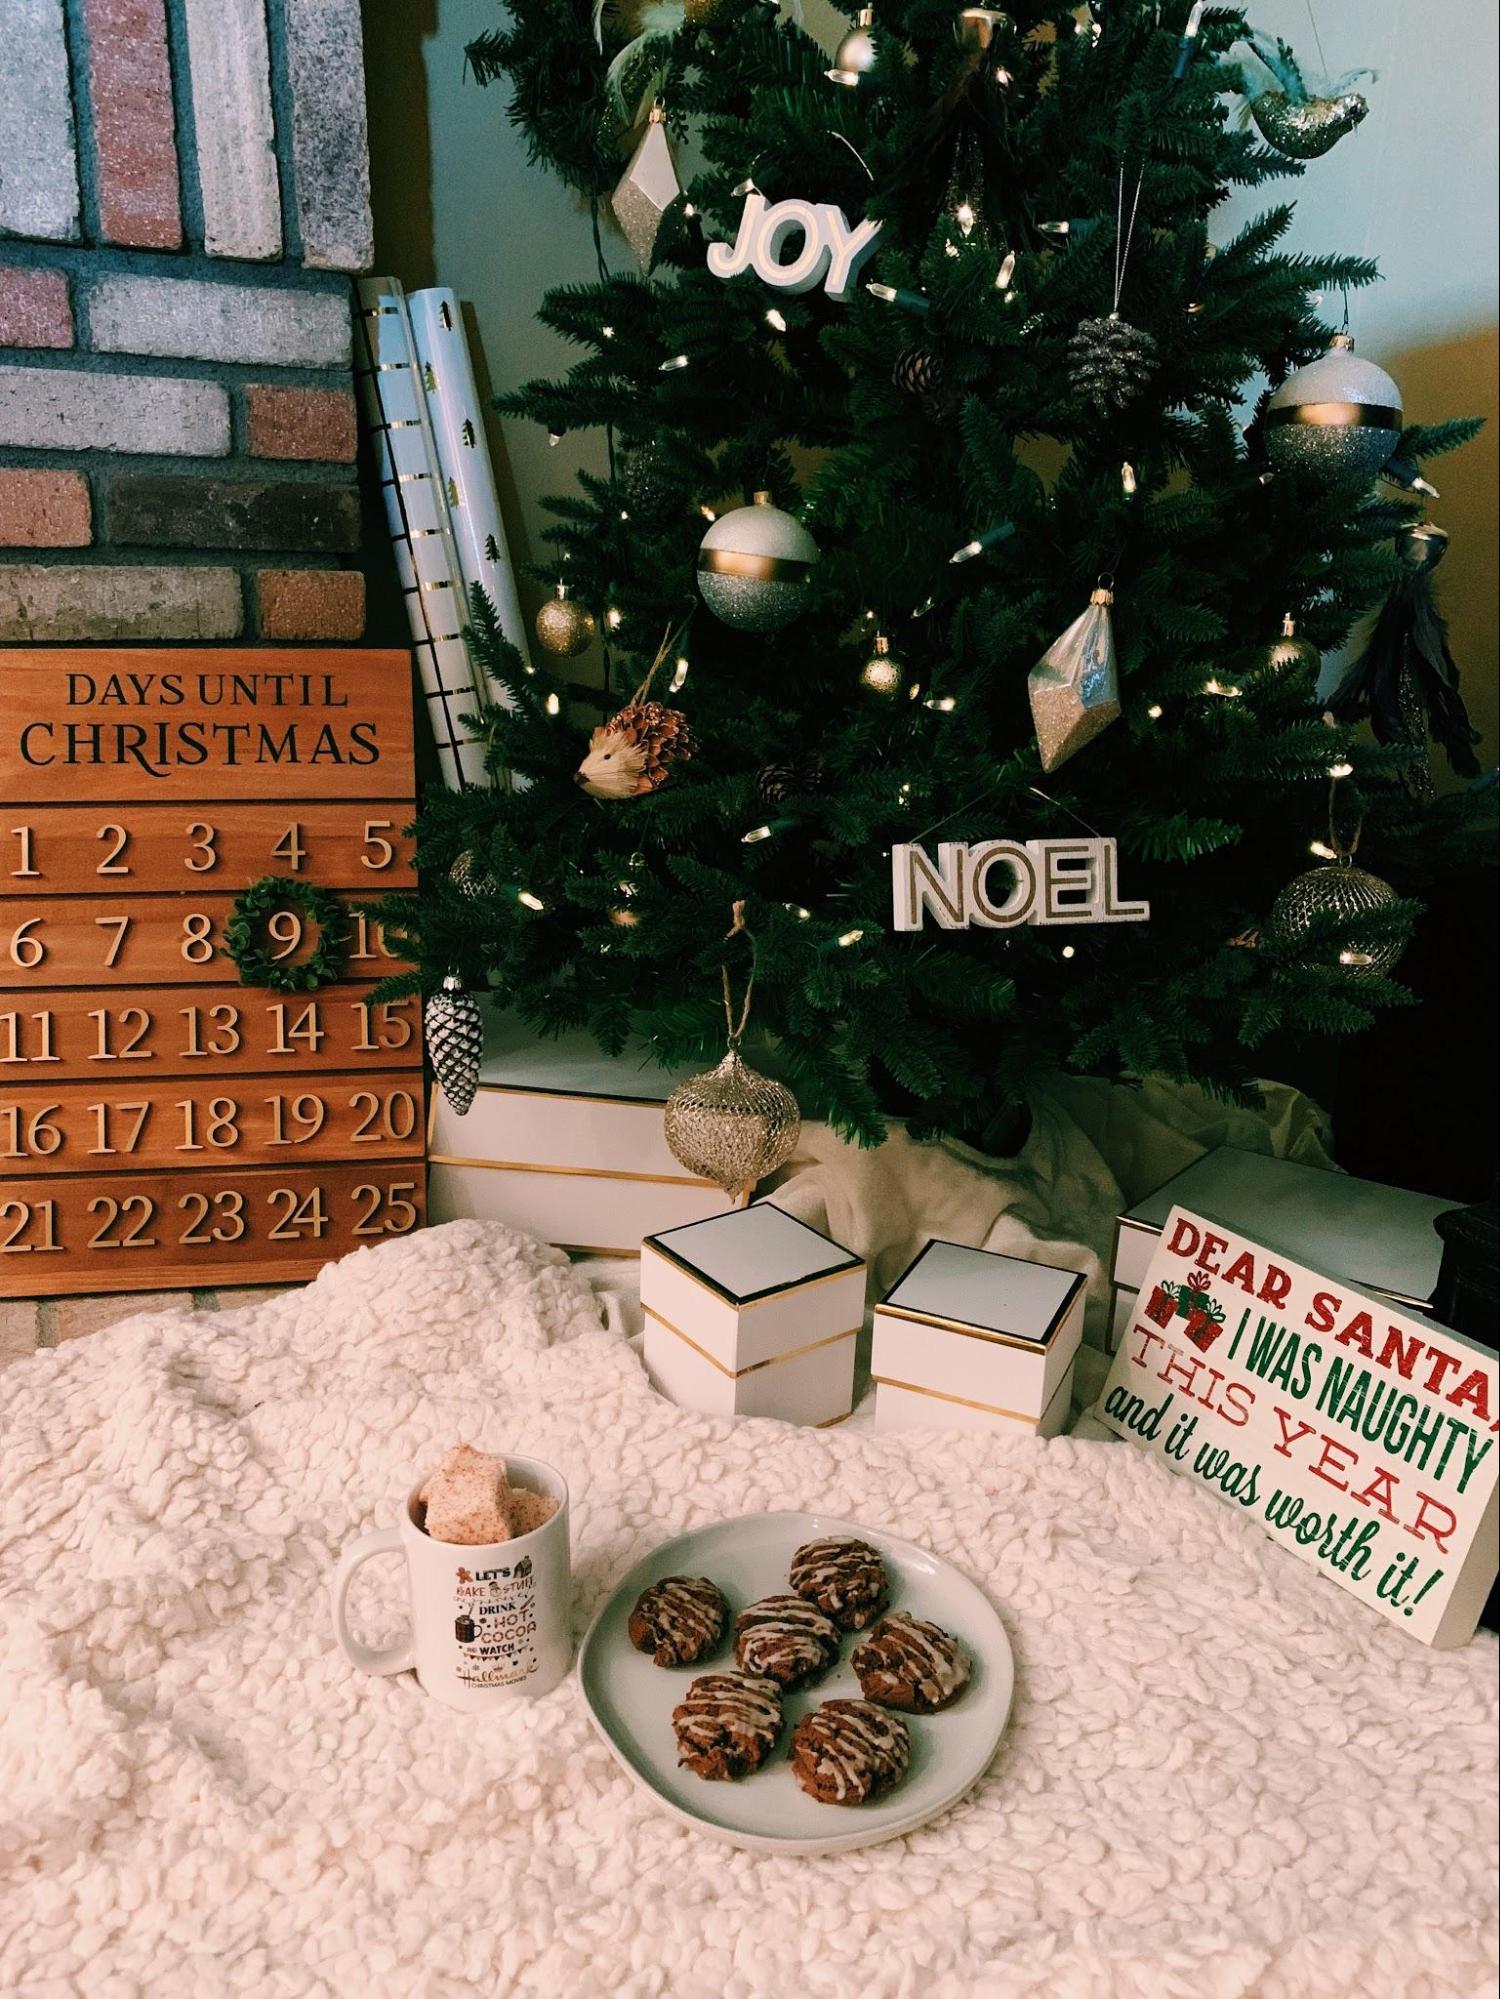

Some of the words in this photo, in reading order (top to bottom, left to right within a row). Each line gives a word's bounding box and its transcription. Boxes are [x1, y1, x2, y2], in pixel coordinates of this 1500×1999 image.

[706, 193, 886, 301] JOY
[66, 673, 185, 706] DAYS
[197, 673, 348, 707] UNTIL
[20, 721, 381, 778] CHRISTMAS
[10, 825, 41, 877] 1
[95, 824, 130, 875] 2
[183, 821, 218, 872] 3
[270, 821, 307, 871] 4
[359, 819, 394, 870] 5
[892, 837, 1150, 932] NOEL
[9, 917, 45, 968] 6
[94, 915, 130, 967] 7
[180, 912, 214, 965] 8
[267, 910, 301, 962] 9
[0, 1010, 61, 1063] 11
[87, 1007, 153, 1060] 12
[178, 1004, 241, 1056] 13
[266, 1002, 325, 1053] 14
[350, 1000, 412, 1051] 15
[0, 1103, 63, 1158] 16
[86, 1101, 151, 1155] 17
[174, 1097, 240, 1150] 18
[263, 1094, 326, 1145] 19
[348, 1090, 416, 1142] 20
[0, 1200, 65, 1253] 21
[86, 1195, 156, 1249] 22
[178, 1191, 246, 1244] 23
[266, 1186, 329, 1239] 24
[350, 1182, 417, 1236] 25
[1167, 1217, 1293, 1310] DEAR
[1304, 1291, 1499, 1432] SANTA,
[1226, 1307, 1253, 1360] I
[1245, 1315, 1323, 1400] WAS
[1315, 1355, 1495, 1495] NAUGHTY
[1130, 1324, 1257, 1428] THIS
[1272, 1406, 1458, 1555] YEAR
[1103, 1383, 1163, 1443] and
[1163, 1412, 1194, 1462] it
[1193, 1442, 1262, 1507] was
[1264, 1487, 1382, 1581] worth
[1376, 1551, 1445, 1618] it!
[456, 1586, 486, 1597] BAKE
[475, 1567, 511, 1582] LET'S
[479, 1603, 517, 1616] DRINK
[481, 1621, 537, 1644] COCOA
[493, 1609, 529, 1629] HOT
[456, 1663, 540, 1688] Hallmark
[479, 1642, 515, 1655] WATCH
